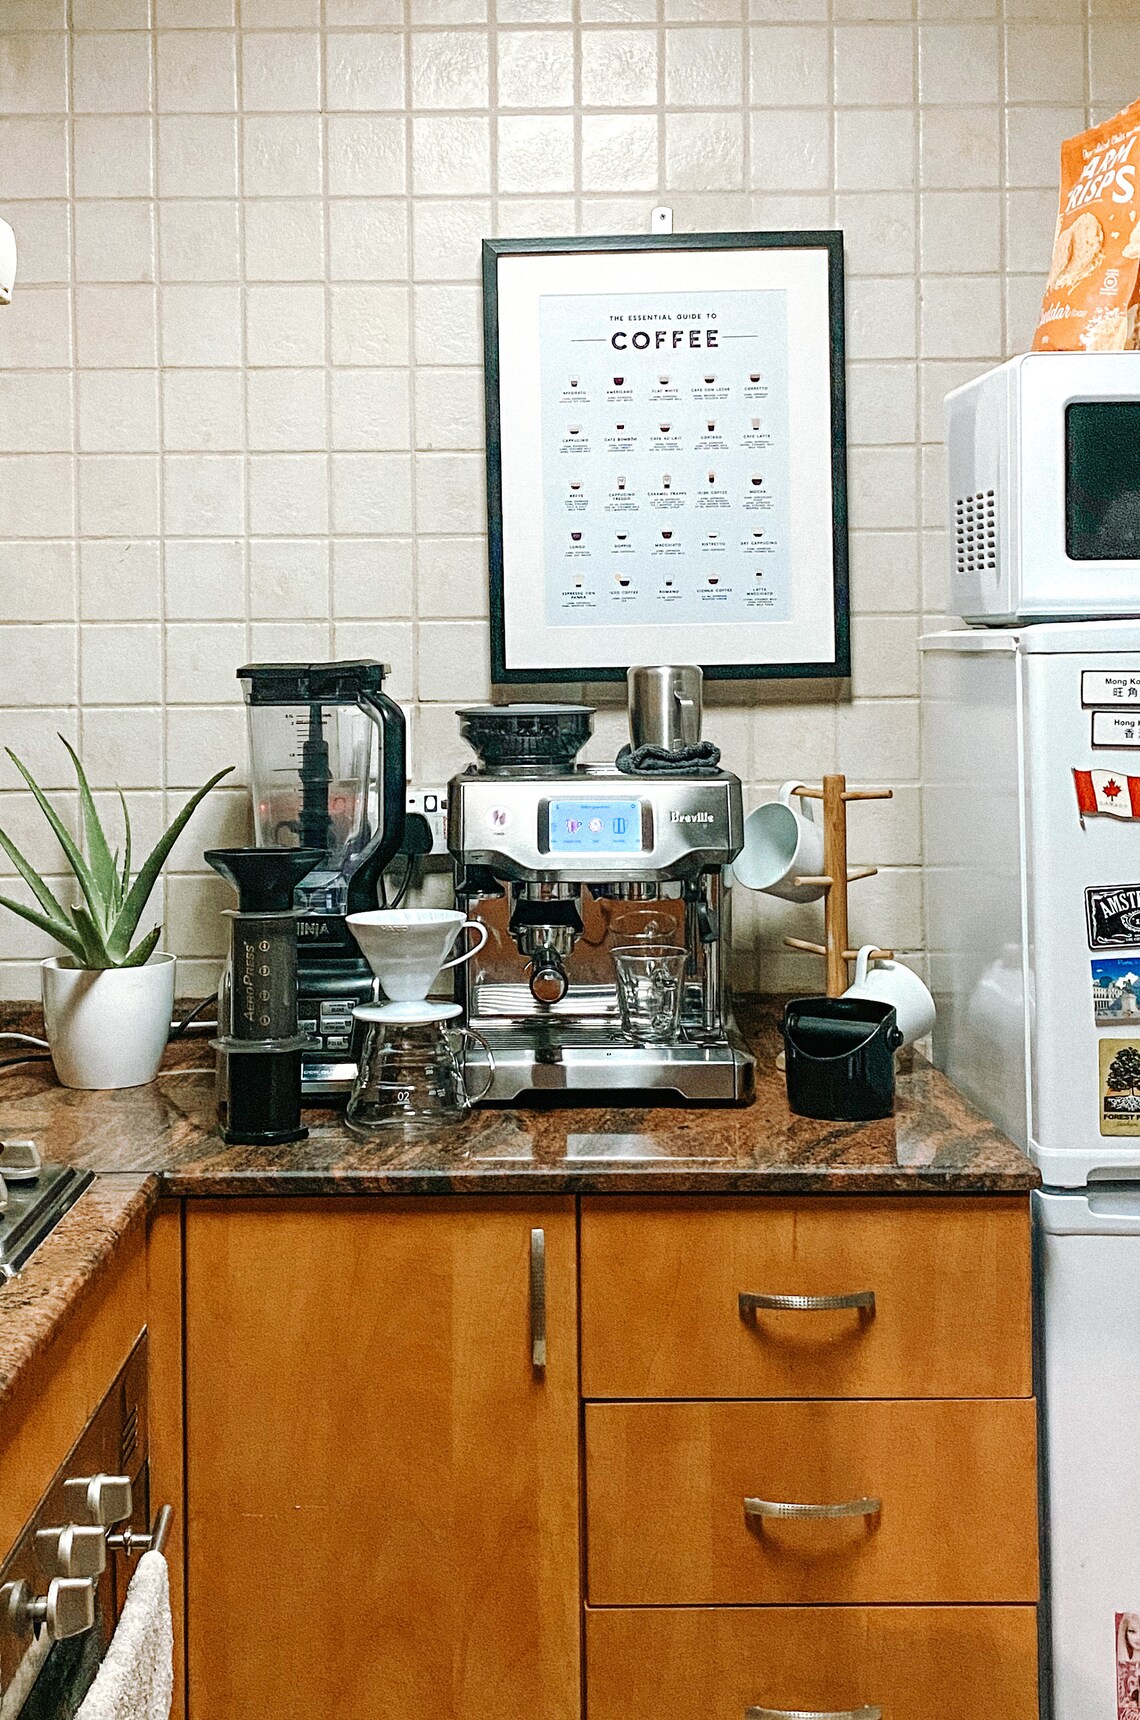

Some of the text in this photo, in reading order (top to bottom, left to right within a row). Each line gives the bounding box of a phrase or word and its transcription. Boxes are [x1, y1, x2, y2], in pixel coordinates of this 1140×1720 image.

[611, 330, 719, 350] COFFEE
[1105, 679, 1128, 687] Mong
[1114, 720, 1136, 729] Hong
[670, 811, 715, 823] Breville
[297, 922, 329, 937] INJA
[397, 1091, 410, 1101] 02
